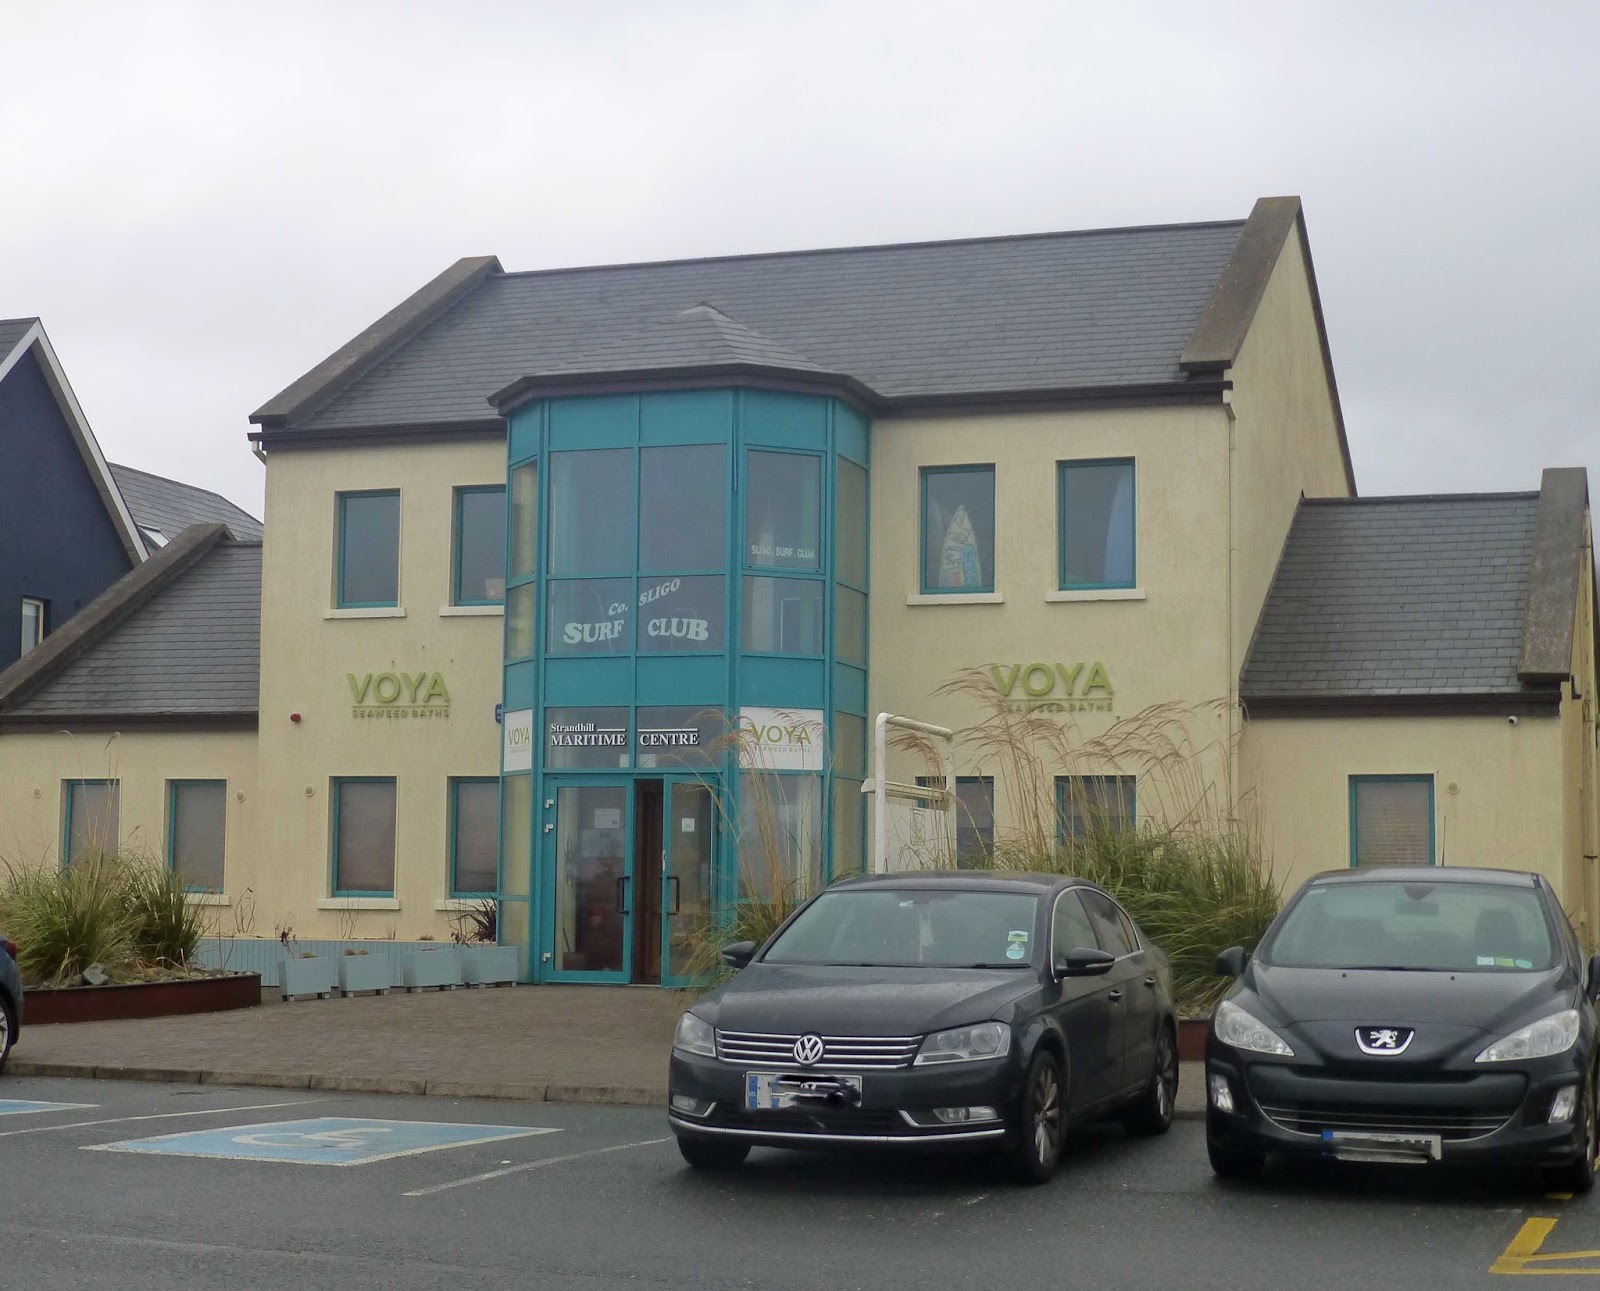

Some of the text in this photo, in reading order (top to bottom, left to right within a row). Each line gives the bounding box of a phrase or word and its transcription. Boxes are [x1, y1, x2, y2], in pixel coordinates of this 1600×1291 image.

[775, 547, 793, 557] SURF
[608, 578, 681, 616] Co. SLIGO
[563, 617, 709, 644] SURF CLUB
[347, 672, 450, 703] VOYA
[991, 662, 1114, 696] VOYA
[352, 709, 450, 718] SEAWEED BATHS
[1069, 702, 1113, 712] BATHS
[508, 727, 530, 746] VOYA
[550, 723, 595, 732] Strandhill
[752, 724, 811, 744] VOYA
[550, 733, 699, 746] MARITIME CENTRE
